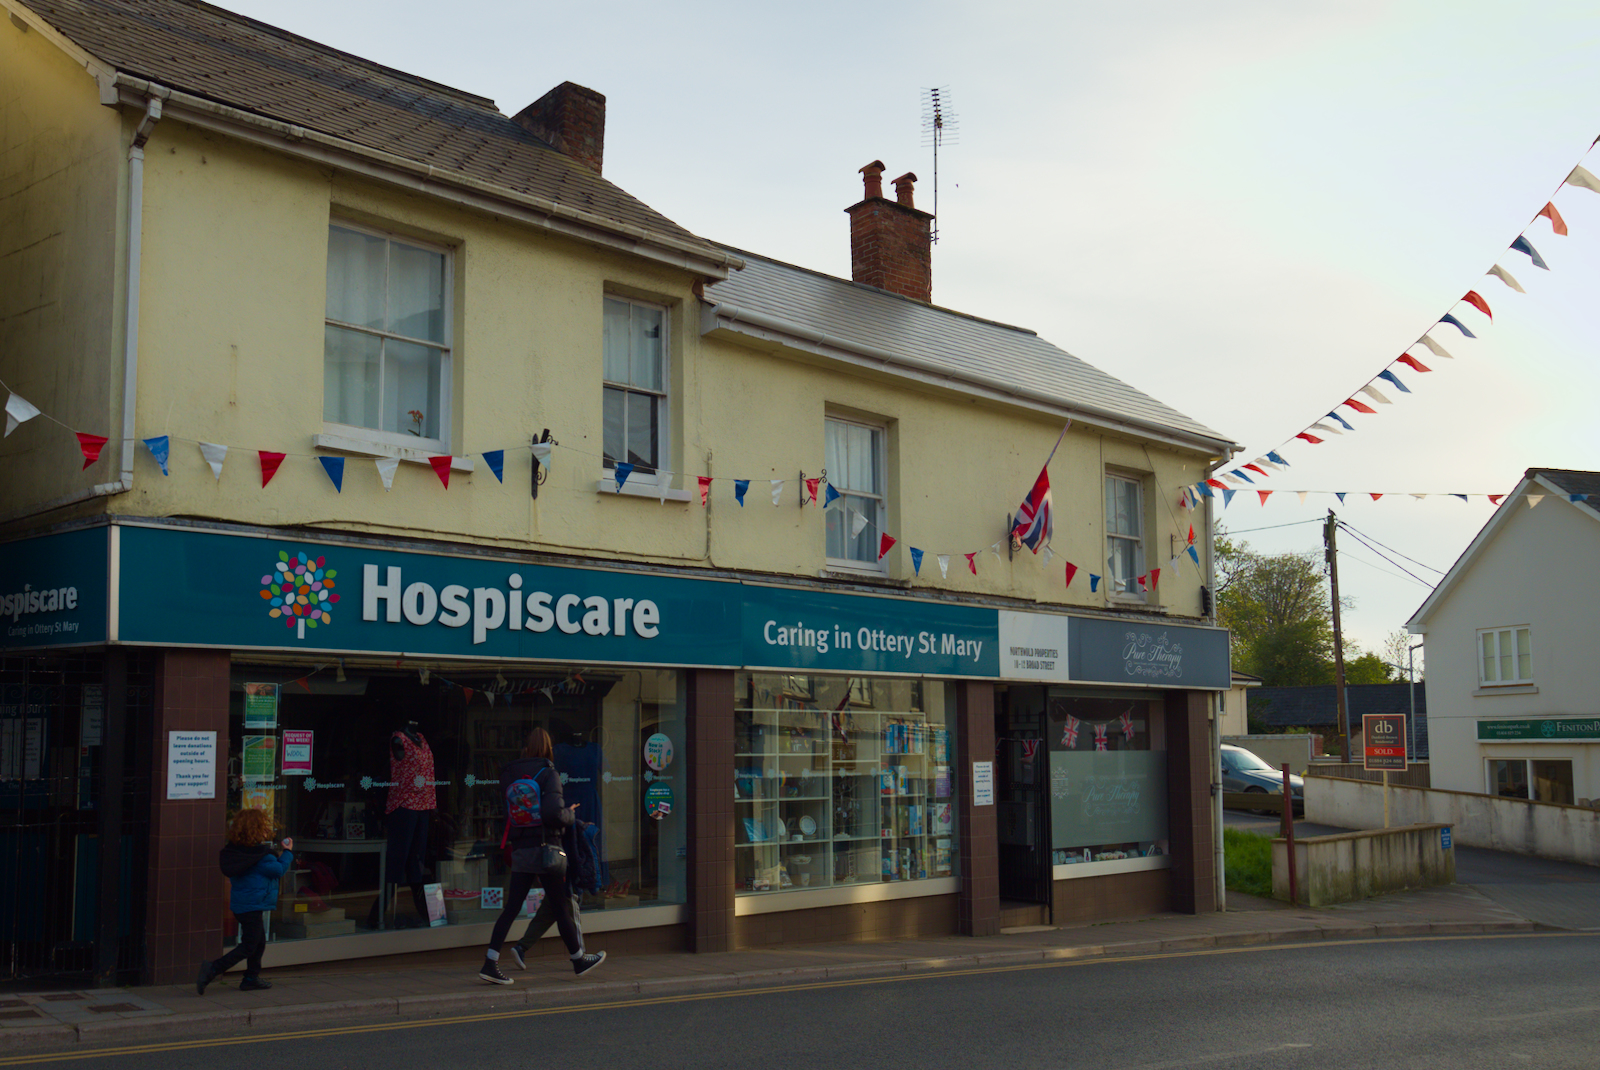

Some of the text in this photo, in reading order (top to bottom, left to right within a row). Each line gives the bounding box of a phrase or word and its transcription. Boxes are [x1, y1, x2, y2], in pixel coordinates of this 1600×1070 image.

[363, 563, 660, 645] Hospiscare
[8, 620, 80, 637] Caring in Ottery St Mary
[764, 620, 982, 662] Caring in Ottery St Mary
[1034, 648, 1058, 659] PROPERTIES
[1122, 642, 1182, 670] Pure Therapy
[1026, 660, 1039, 670] BROAD
[1040, 660, 1055, 670] STREET
[1375, 720, 1393, 734] db
[258, 782, 287, 790] Hospiscare
[1083, 784, 1140, 807] Pure Therapy
